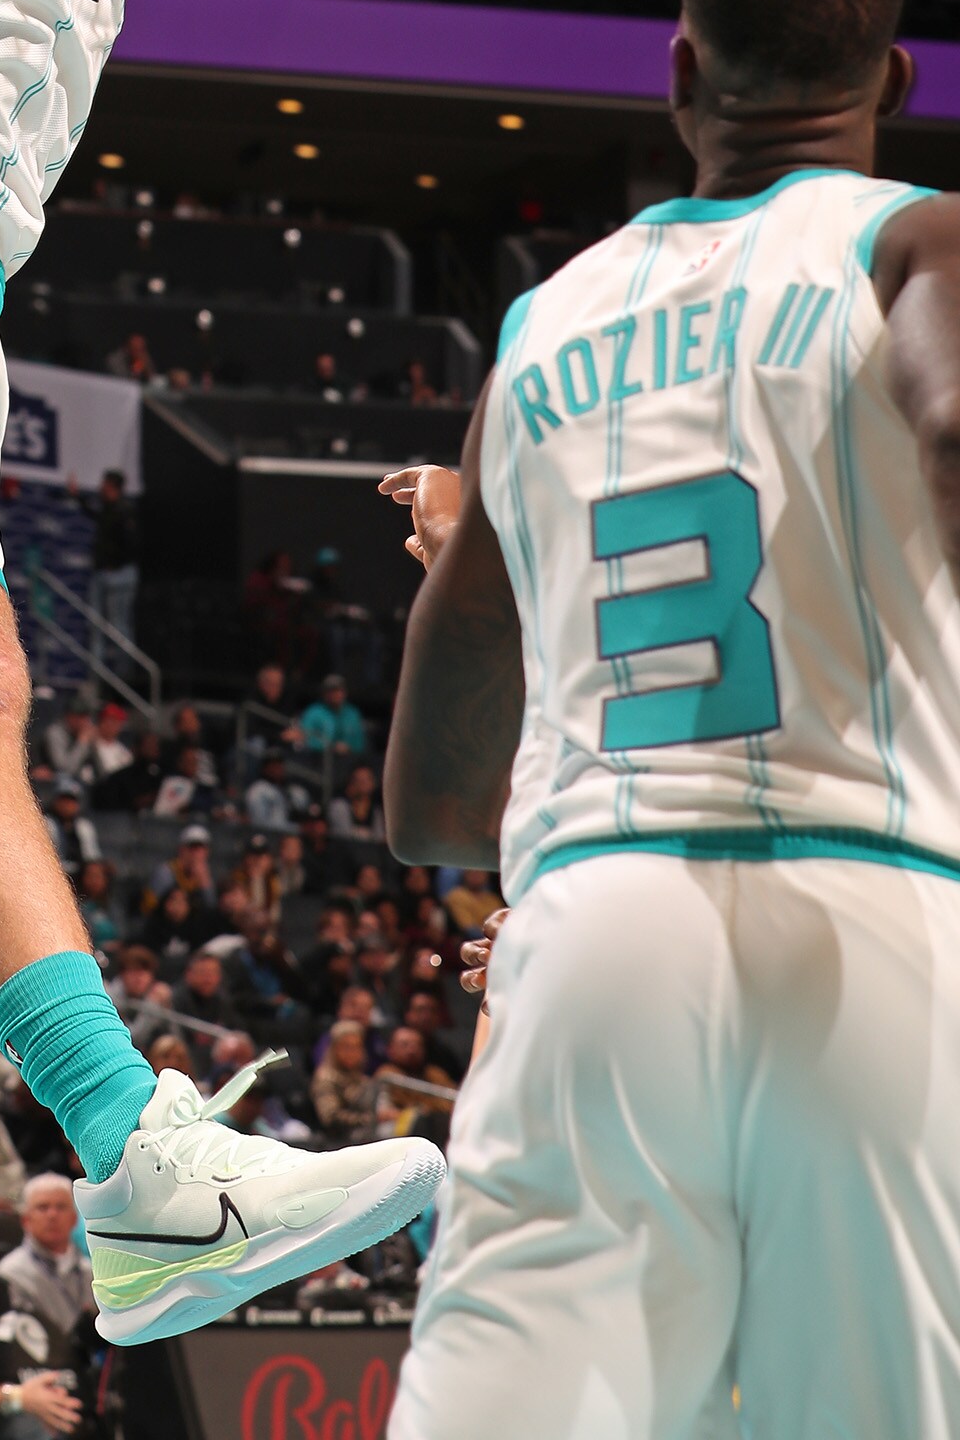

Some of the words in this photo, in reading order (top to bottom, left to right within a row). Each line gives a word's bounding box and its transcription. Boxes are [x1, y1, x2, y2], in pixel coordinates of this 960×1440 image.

[512, 286, 747, 446] ROZIER
[756, 283, 836, 368] III
[589, 467, 782, 753] 3
